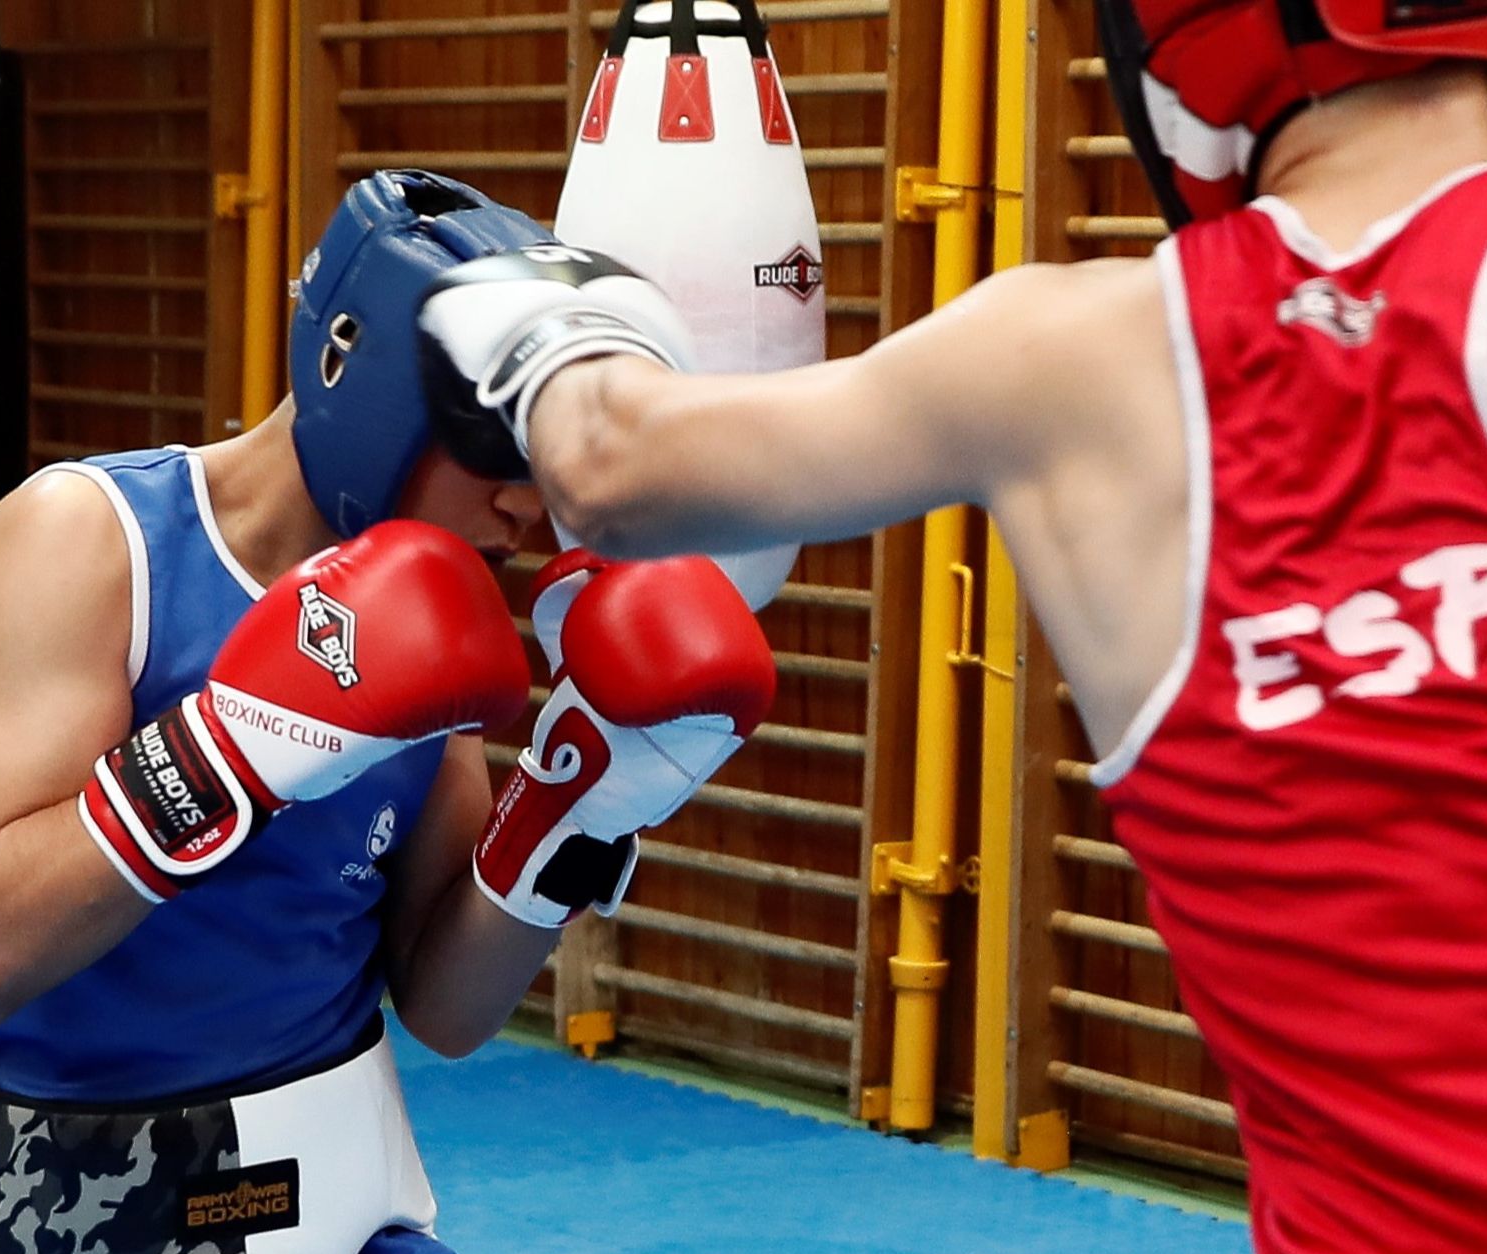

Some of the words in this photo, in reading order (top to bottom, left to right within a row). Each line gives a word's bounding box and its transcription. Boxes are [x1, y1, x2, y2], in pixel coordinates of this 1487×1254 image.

[758, 266, 799, 285] RUDE
[298, 583, 331, 631] RUDE
[320, 635, 359, 689] BOYS
[141, 720, 172, 769] RUDE
[216, 694, 284, 736] BOXING
[288, 723, 343, 754] CLUB
[156, 765, 206, 827] BOYS
[187, 1191, 234, 1211] ARMY
[252, 1181, 289, 1199] WAR
[187, 1196, 290, 1227] BOXING
